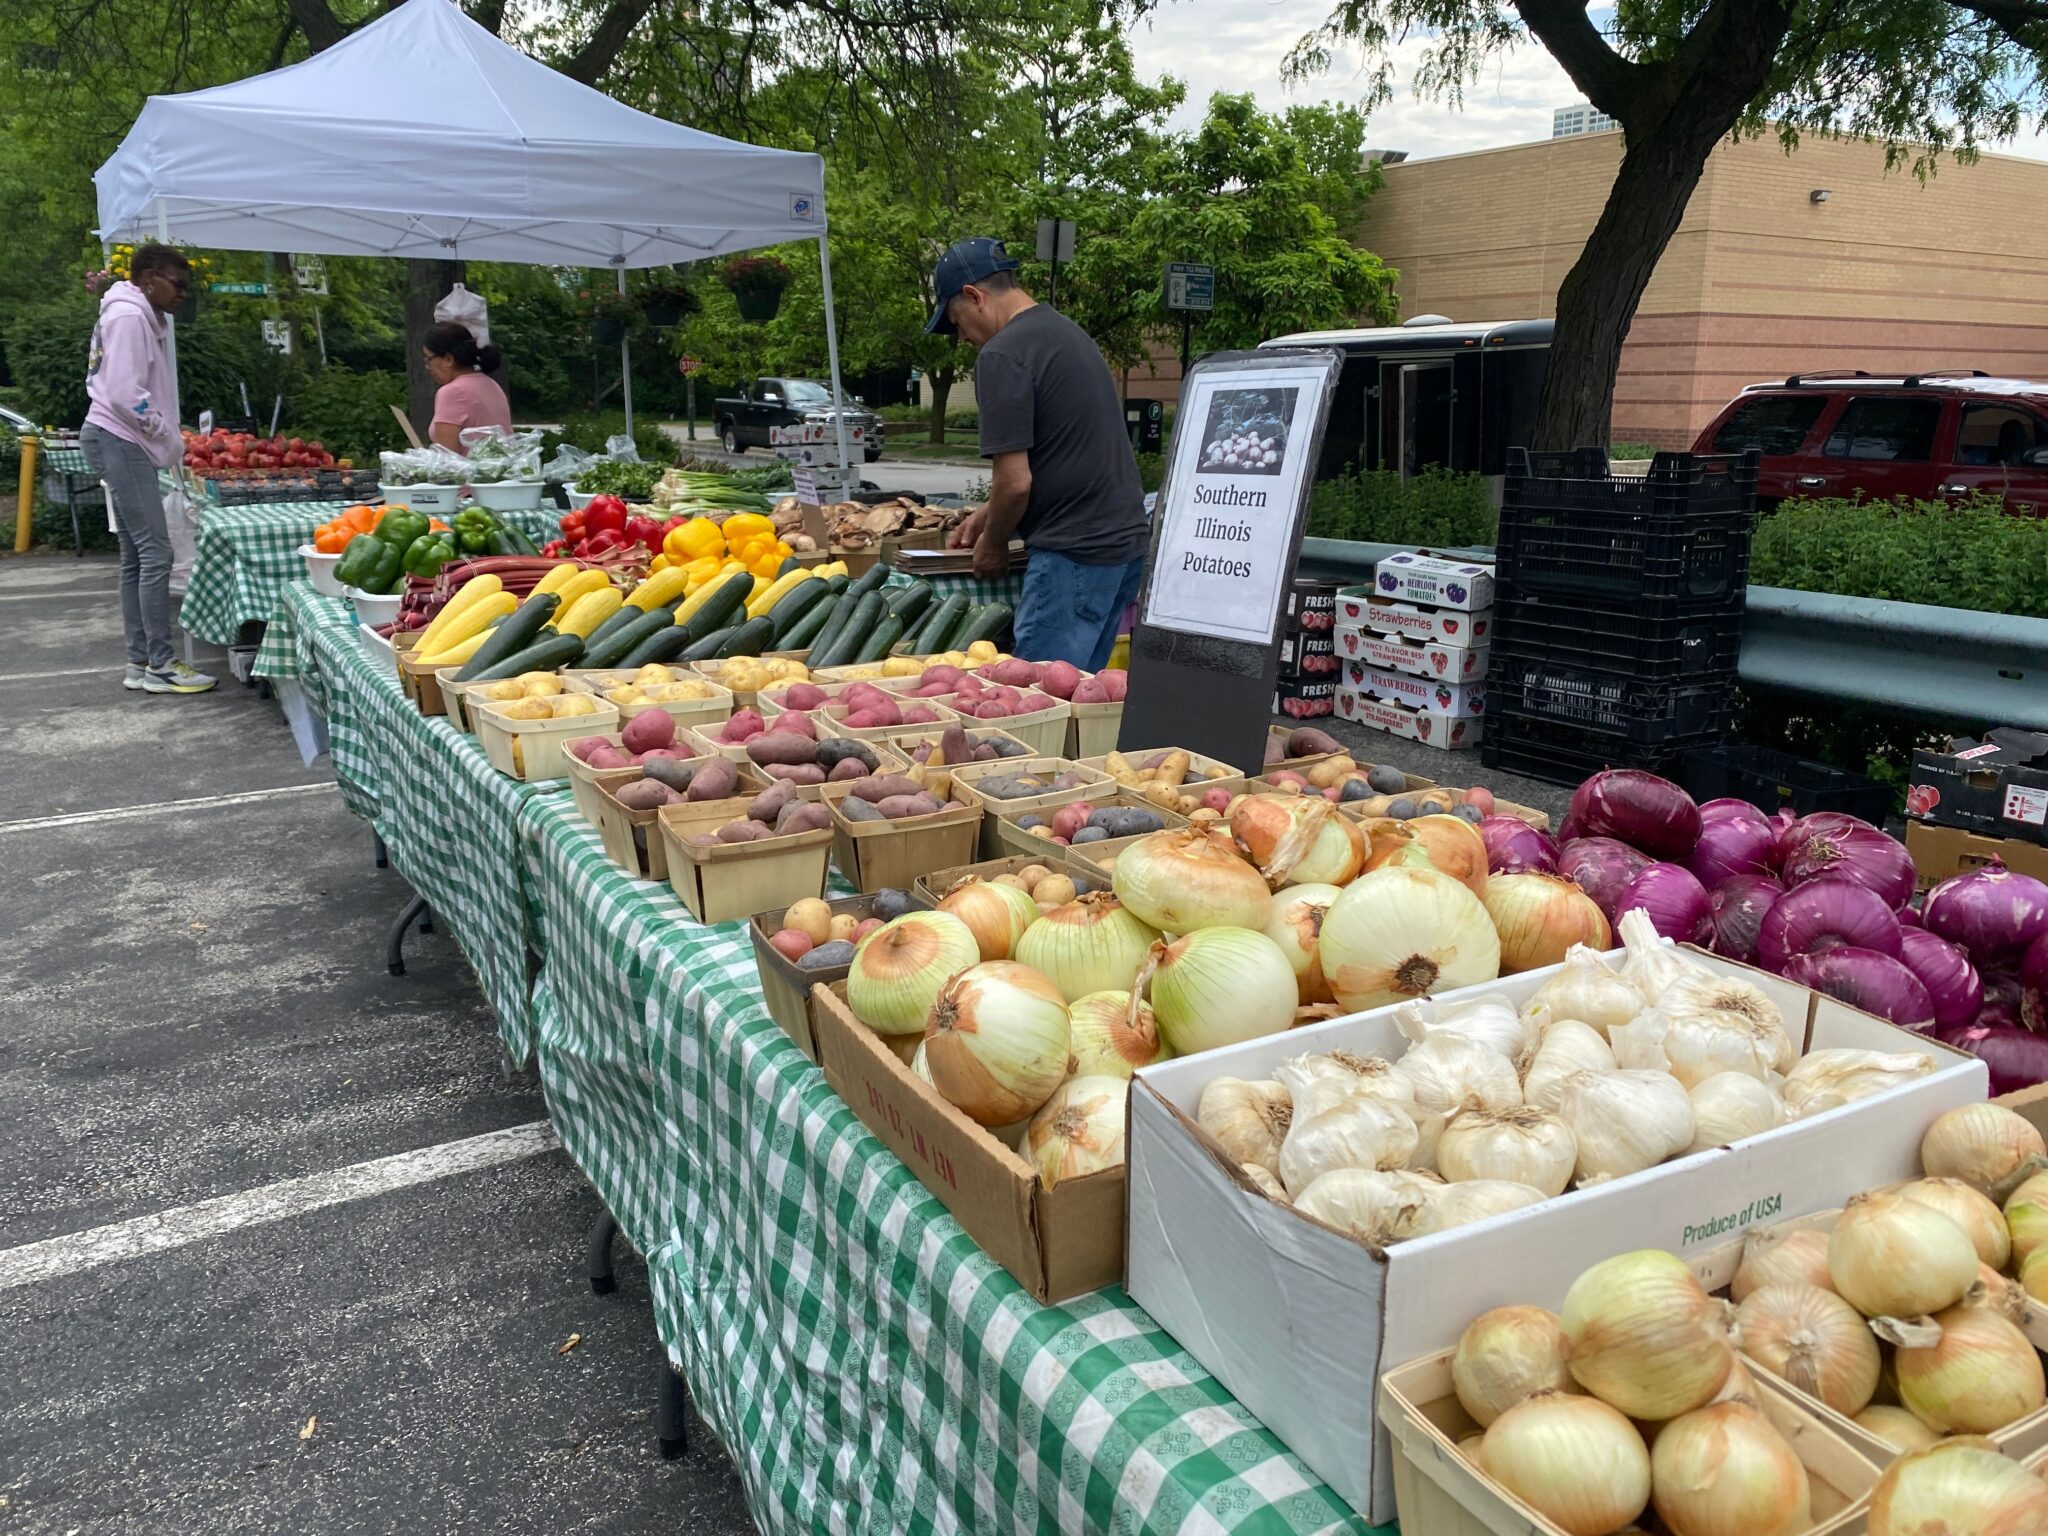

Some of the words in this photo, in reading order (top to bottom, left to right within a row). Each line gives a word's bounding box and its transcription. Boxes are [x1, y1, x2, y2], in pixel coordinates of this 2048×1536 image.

[1194, 483, 1267, 508] Southern
[1194, 517, 1251, 542] Illinois
[1182, 551, 1251, 578] Potatoes
[1408, 578, 1437, 591] HEIRLOOM
[1305, 596, 1334, 608] FRESH
[1407, 589, 1436, 601] TOMATOES
[1369, 608, 1433, 630] Strawberries
[1307, 640, 1334, 652] FRESH
[1363, 641, 1383, 652] FANCY
[1385, 645, 1409, 657] FLAVOR
[1410, 649, 1425, 660] BEST
[1372, 651, 1416, 667] STRAWBERRIES
[1302, 683, 1334, 696] FRESH
[1370, 674, 1427, 697] STRAWBERRIES
[1357, 703, 1377, 715] FANCY
[1377, 708, 1398, 720] FLAVOR
[1400, 712, 1412, 724] BEST
[1365, 713, 1403, 729] STRAWBERRIES
[932, 1144, 957, 1190] NET
[1682, 1214, 1737, 1246] Produce
[1739, 1202, 1754, 1226] of
[1756, 1192, 1782, 1220] USA
